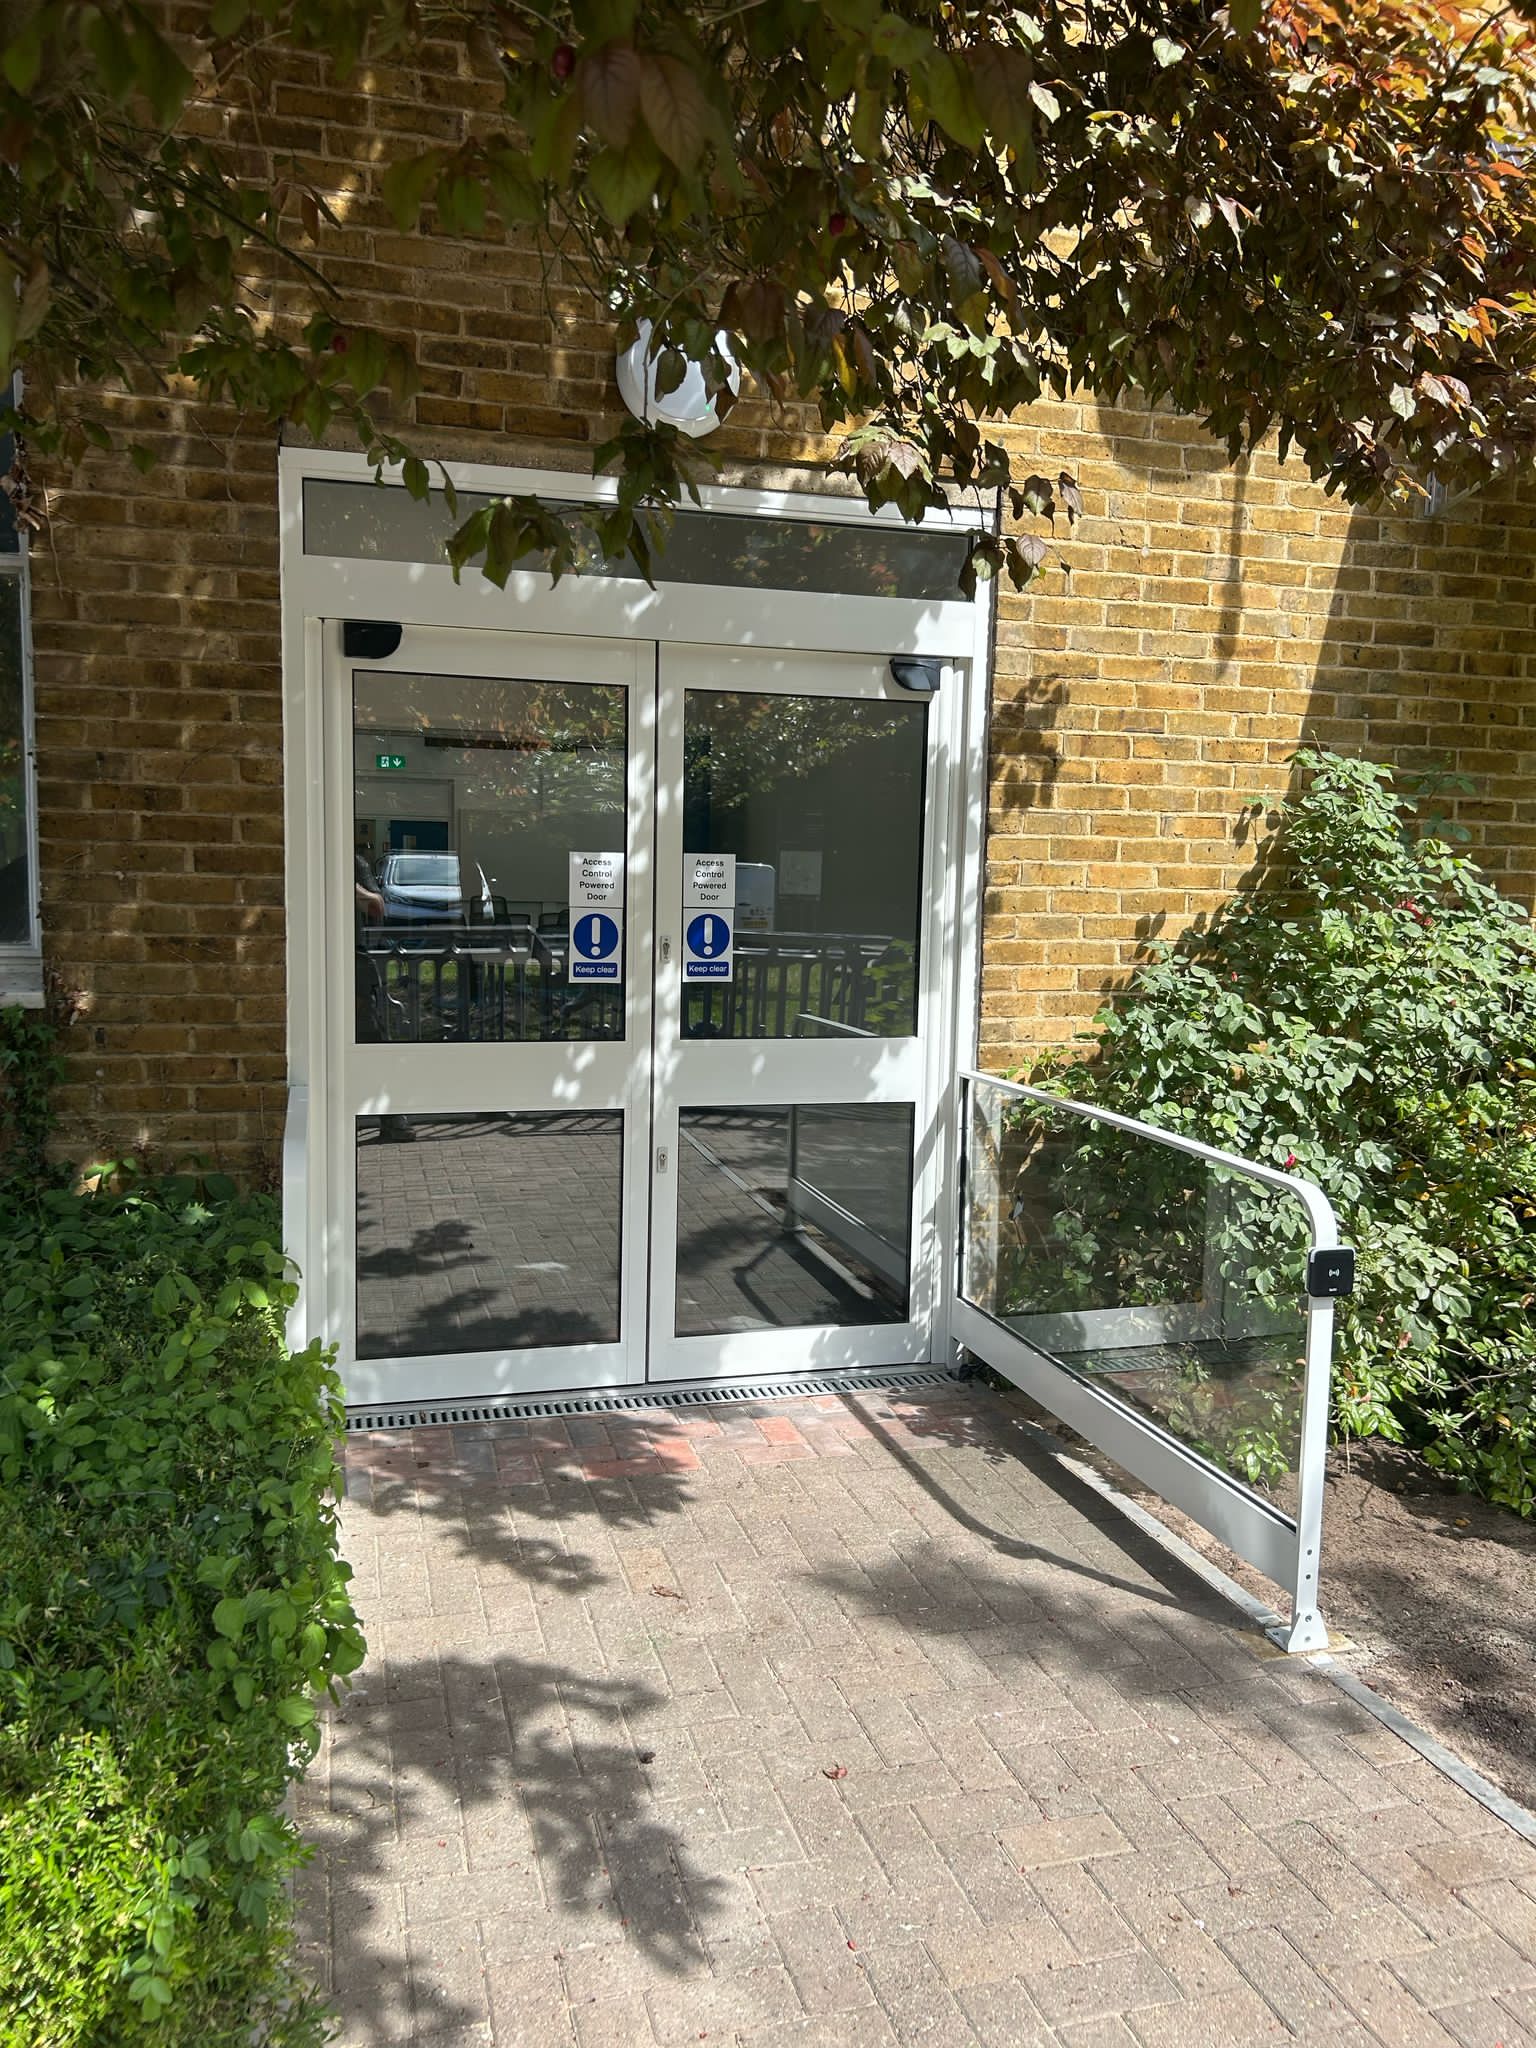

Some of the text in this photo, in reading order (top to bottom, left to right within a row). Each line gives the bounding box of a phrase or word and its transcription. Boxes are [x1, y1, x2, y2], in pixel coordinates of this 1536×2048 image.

[582, 858, 612, 866] Access
[696, 859, 724, 867] Access
[582, 869, 613, 878] Control
[695, 870, 724, 878] Control
[579, 881, 615, 889] Powered
[692, 881, 727, 890] Powered
[700, 893, 720, 901] Door
[575, 965, 616, 975] Keep clear
[688, 965, 727, 974] Keep clear
